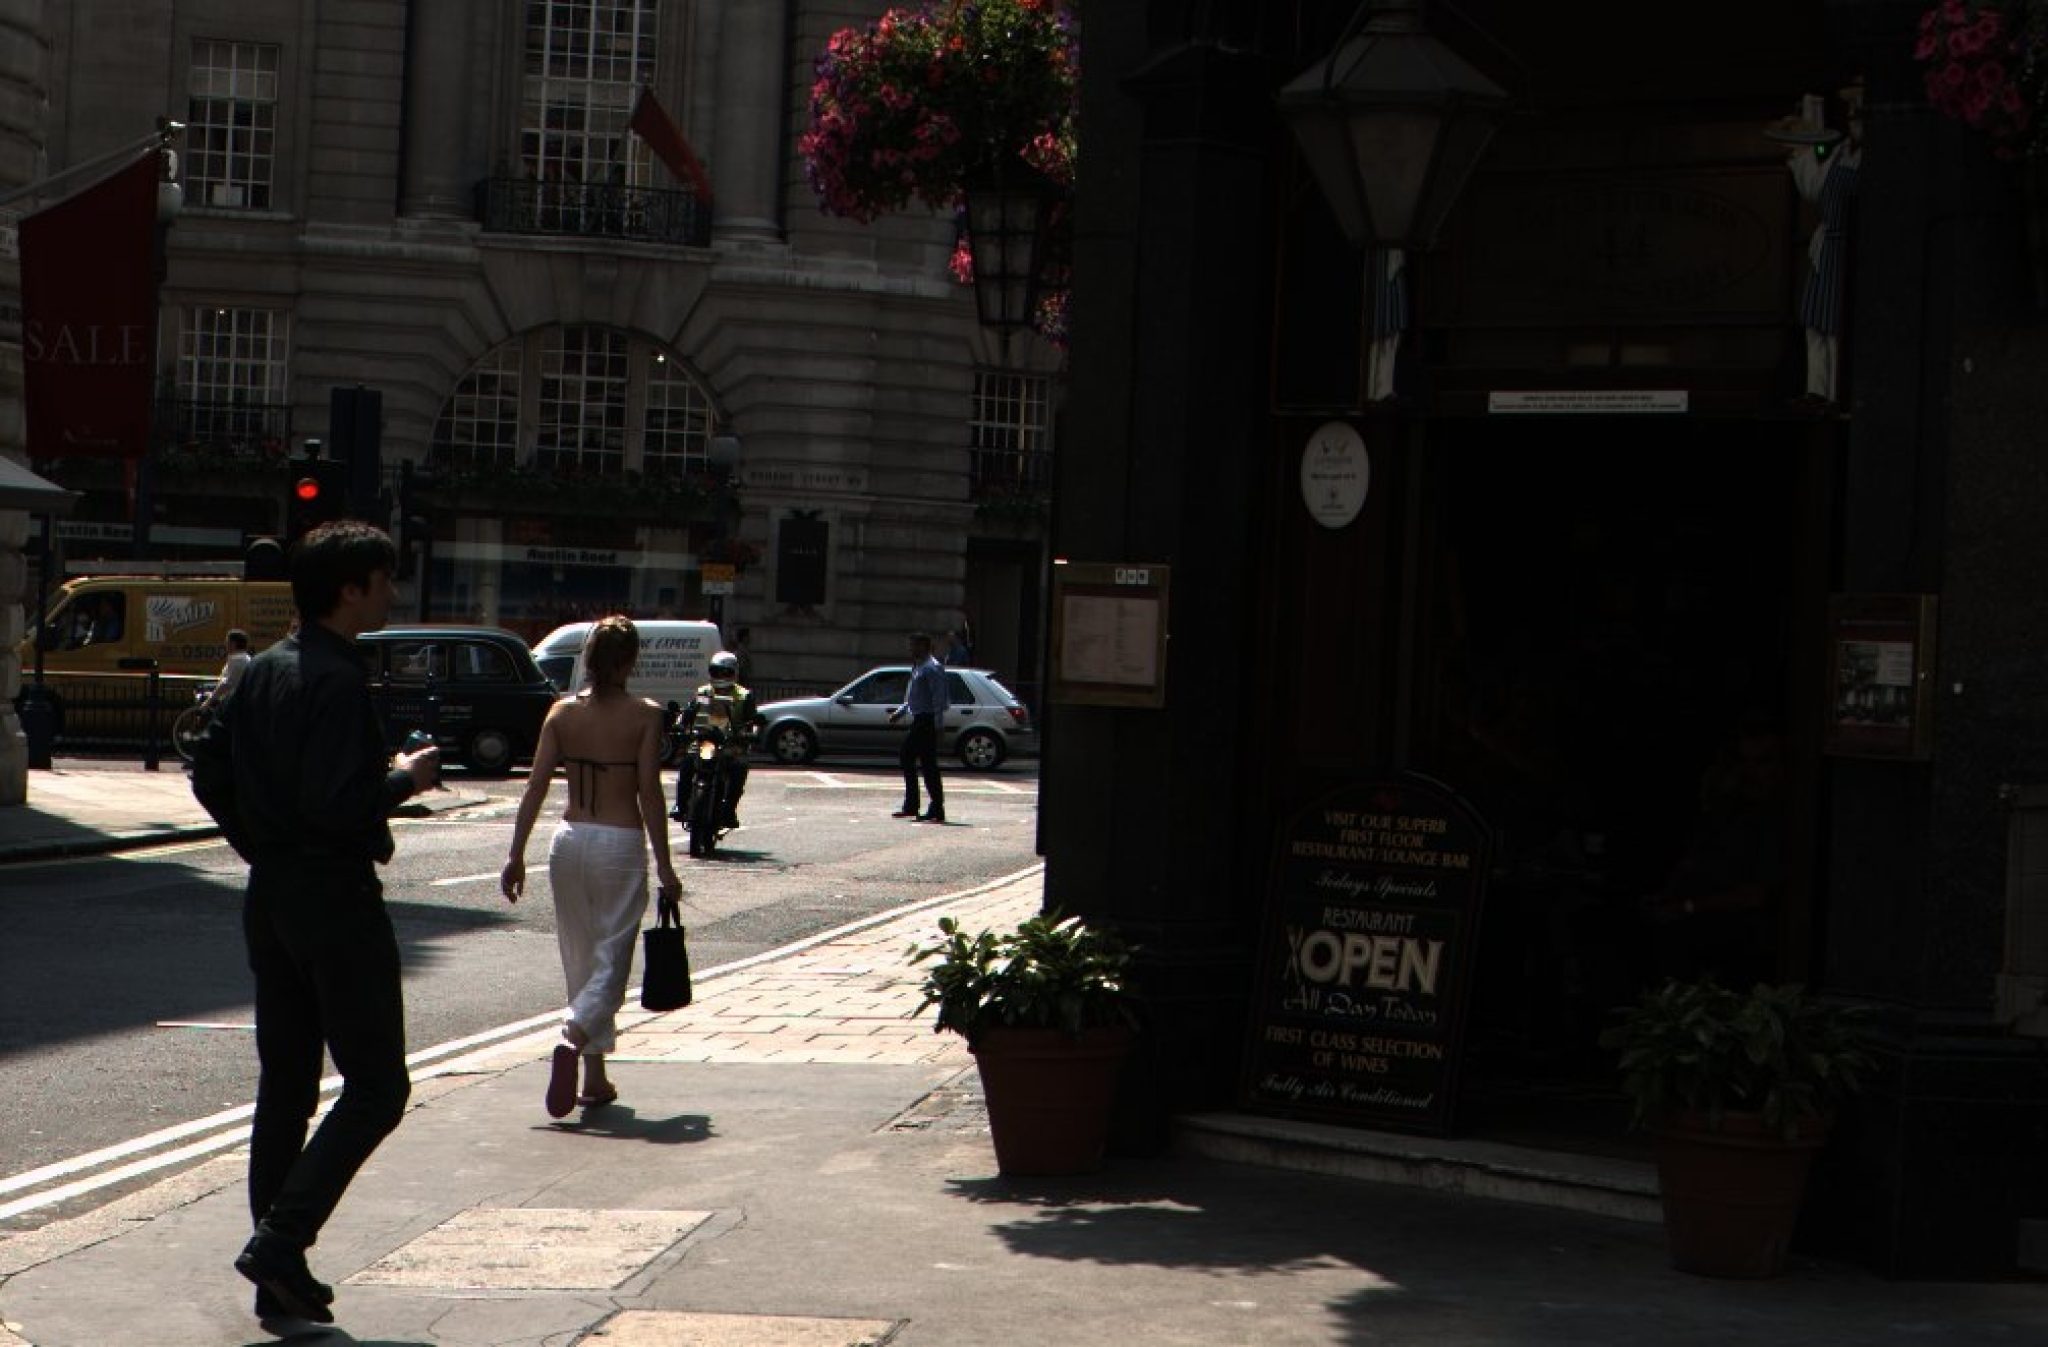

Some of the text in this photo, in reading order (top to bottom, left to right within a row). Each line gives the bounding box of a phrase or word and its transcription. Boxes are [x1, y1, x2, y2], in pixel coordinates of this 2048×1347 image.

[26, 321, 148, 365] SALE
[527, 549, 616, 564] Austin Reed
[1323, 810, 1448, 834] VISIT OUR SUPERB
[1340, 829, 1424, 849] FIRST FLOOR
[1442, 852, 1471, 869] BAR
[1321, 905, 1417, 933] RESTAURANT
[1300, 929, 1446, 995] OPEN
[1283, 983, 1437, 1024] All Day Today
[1264, 1024, 1444, 1061] FIRST CLASS SELECTION
[1312, 1050, 1389, 1074] OF WINES
